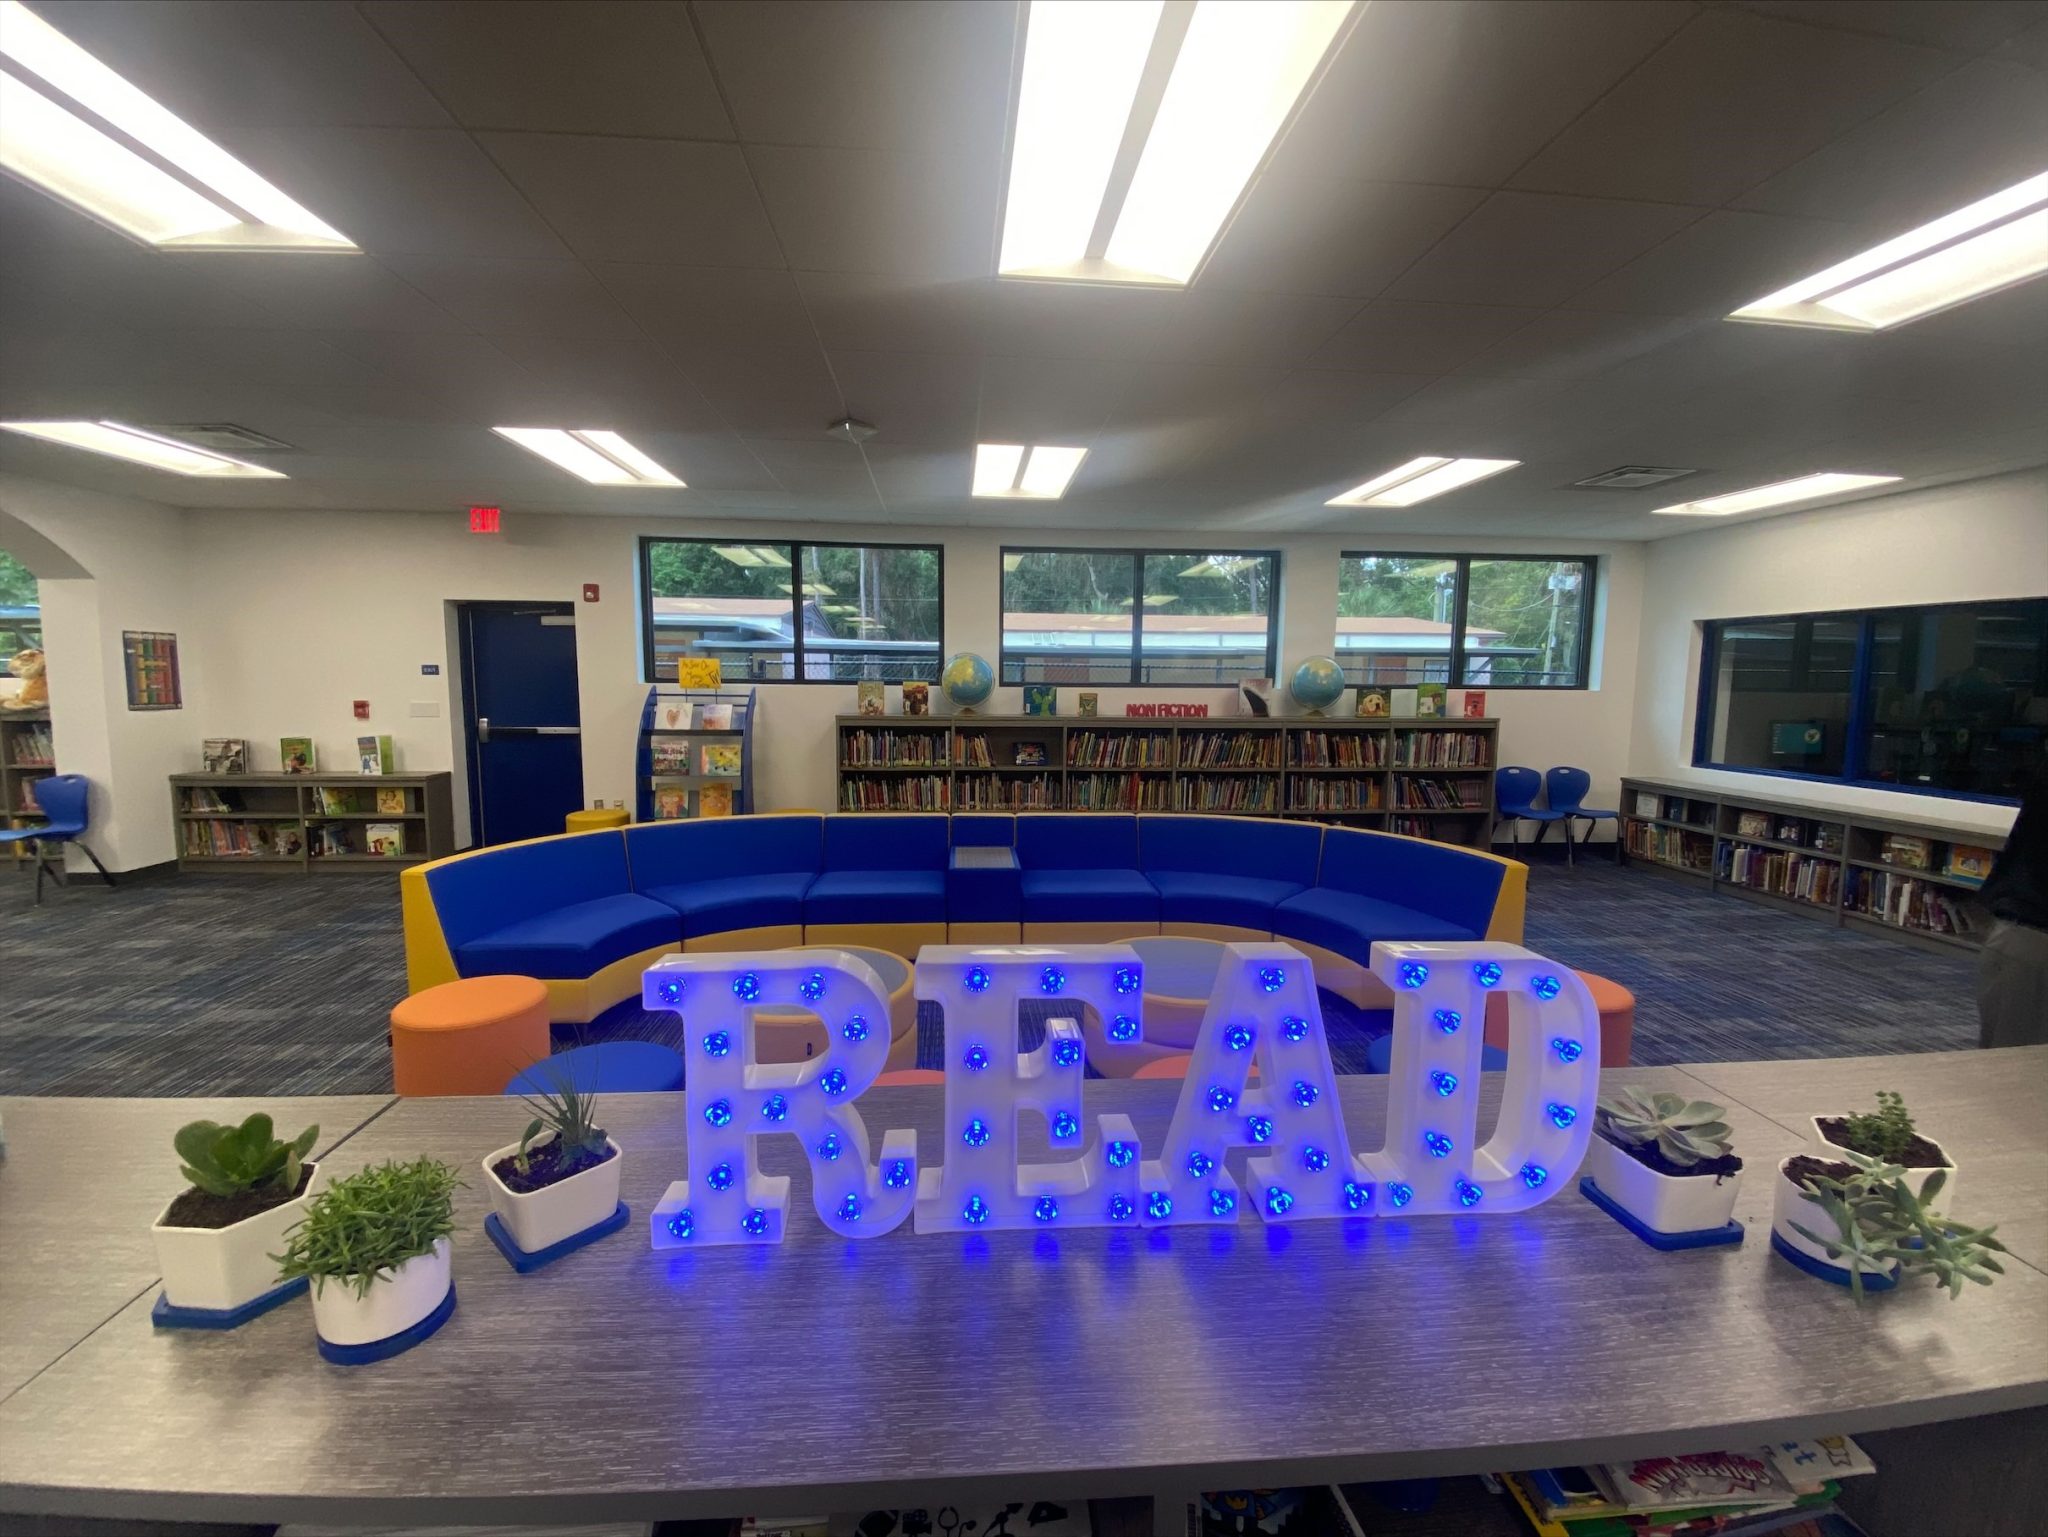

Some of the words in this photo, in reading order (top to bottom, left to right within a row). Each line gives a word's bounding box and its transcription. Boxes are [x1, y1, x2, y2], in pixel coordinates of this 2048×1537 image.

[470, 508, 500, 533] EXIT
[1126, 704, 1156, 718] NON
[1158, 704, 1208, 718] FICTION
[642, 941, 1602, 1249] READ
